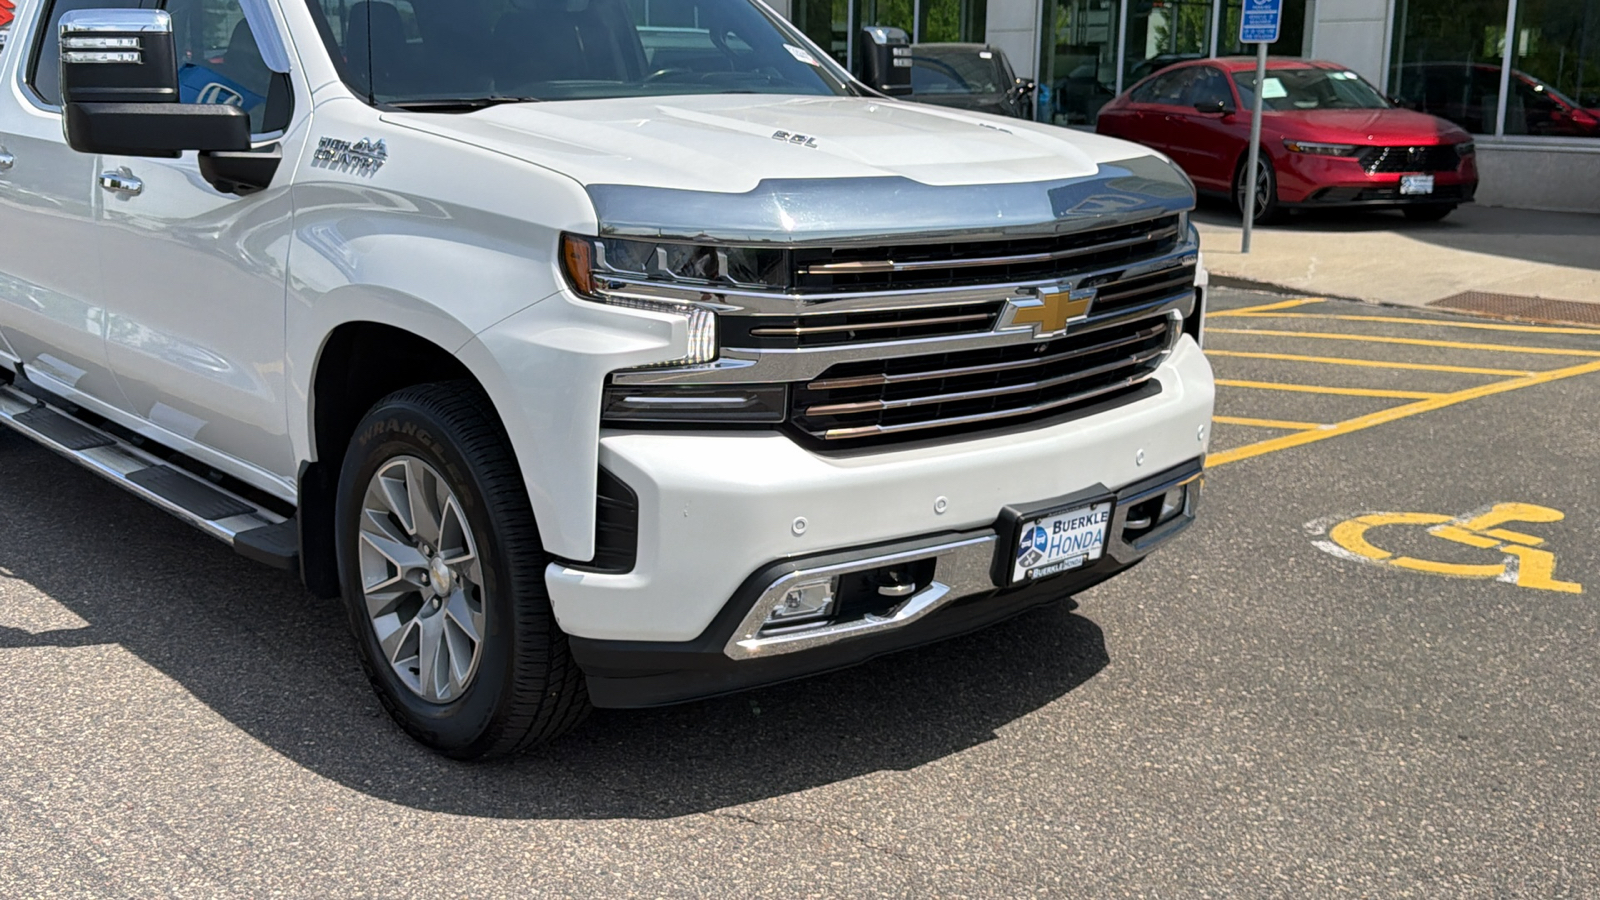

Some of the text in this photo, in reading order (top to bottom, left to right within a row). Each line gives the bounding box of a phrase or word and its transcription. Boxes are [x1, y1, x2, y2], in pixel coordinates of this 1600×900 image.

[319, 136, 351, 152] HIGH
[314, 148, 385, 172] COUNTRY
[1052, 511, 1109, 535] BUERKLE
[1048, 527, 1103, 559] HONDA
